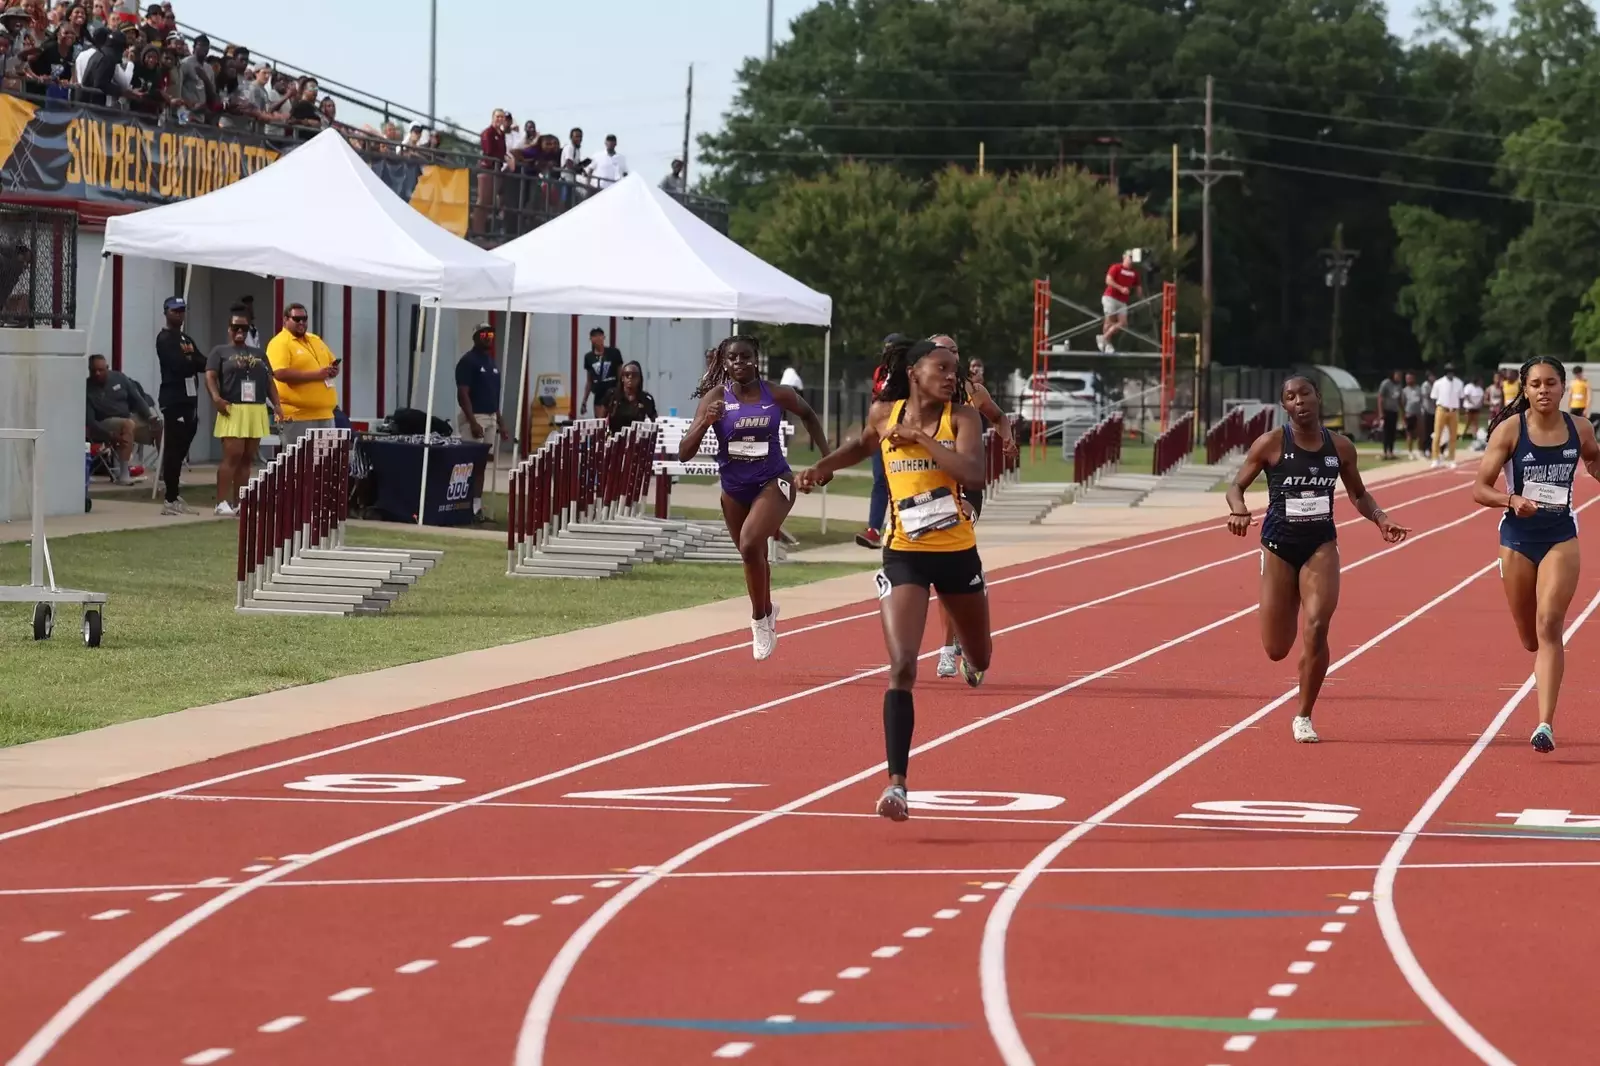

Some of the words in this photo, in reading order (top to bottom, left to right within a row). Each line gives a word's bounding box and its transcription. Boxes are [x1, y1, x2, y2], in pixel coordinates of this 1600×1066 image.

[66, 118, 107, 187] SUN
[111, 123, 154, 193] BELT
[734, 416, 770, 429] JMU
[889, 459, 929, 473] SOUTHERN
[283, 773, 466, 793] 8
